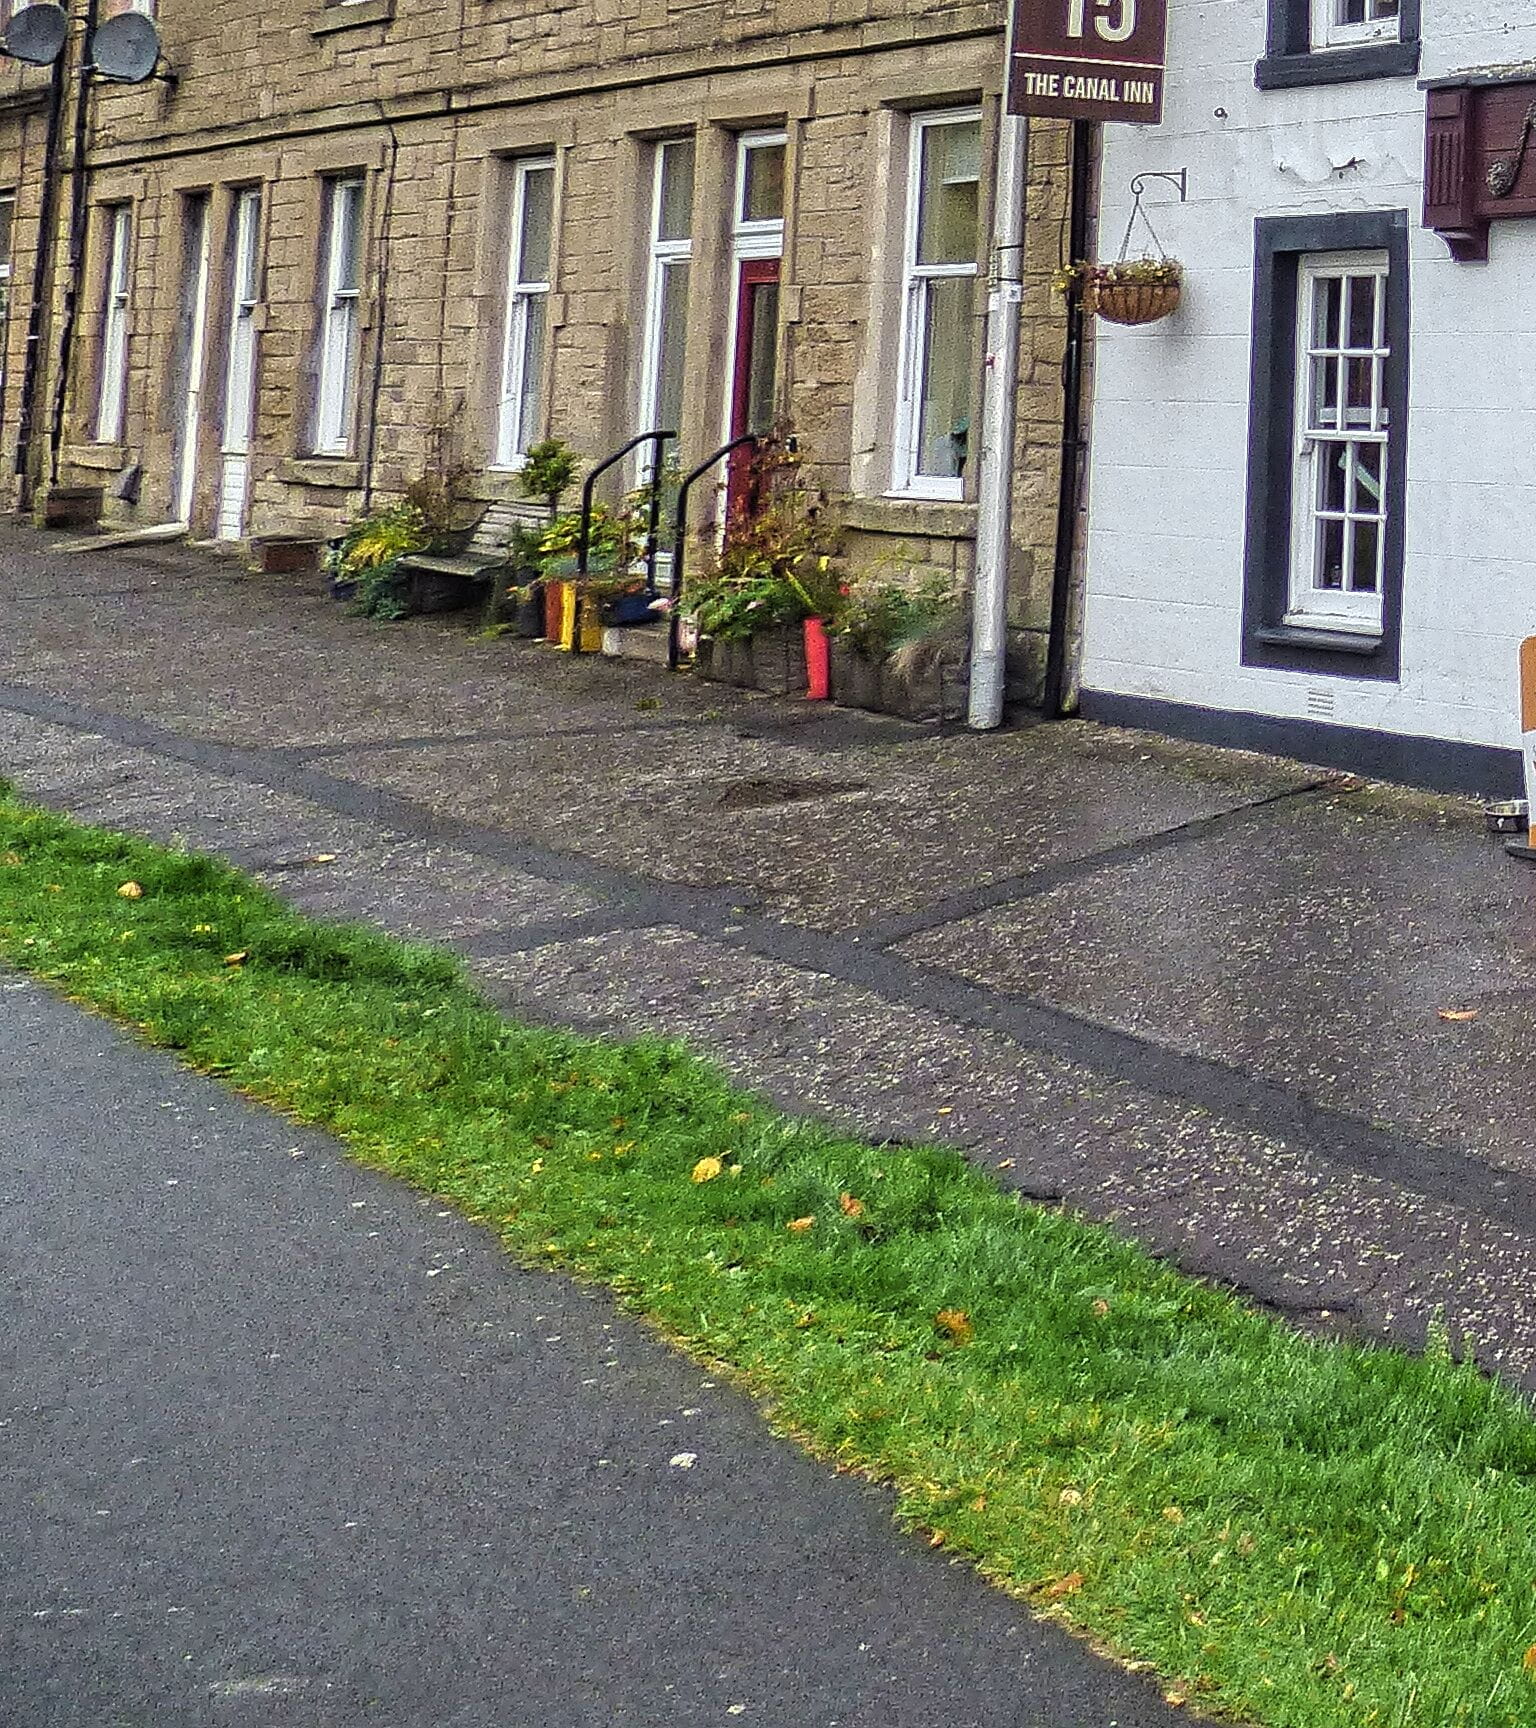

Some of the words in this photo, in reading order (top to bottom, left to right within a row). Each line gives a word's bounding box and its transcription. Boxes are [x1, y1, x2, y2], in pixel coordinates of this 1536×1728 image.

[1025, 72, 1058, 97] THE
[1063, 76, 1120, 102] CANAL
[1123, 81, 1154, 104] INN
